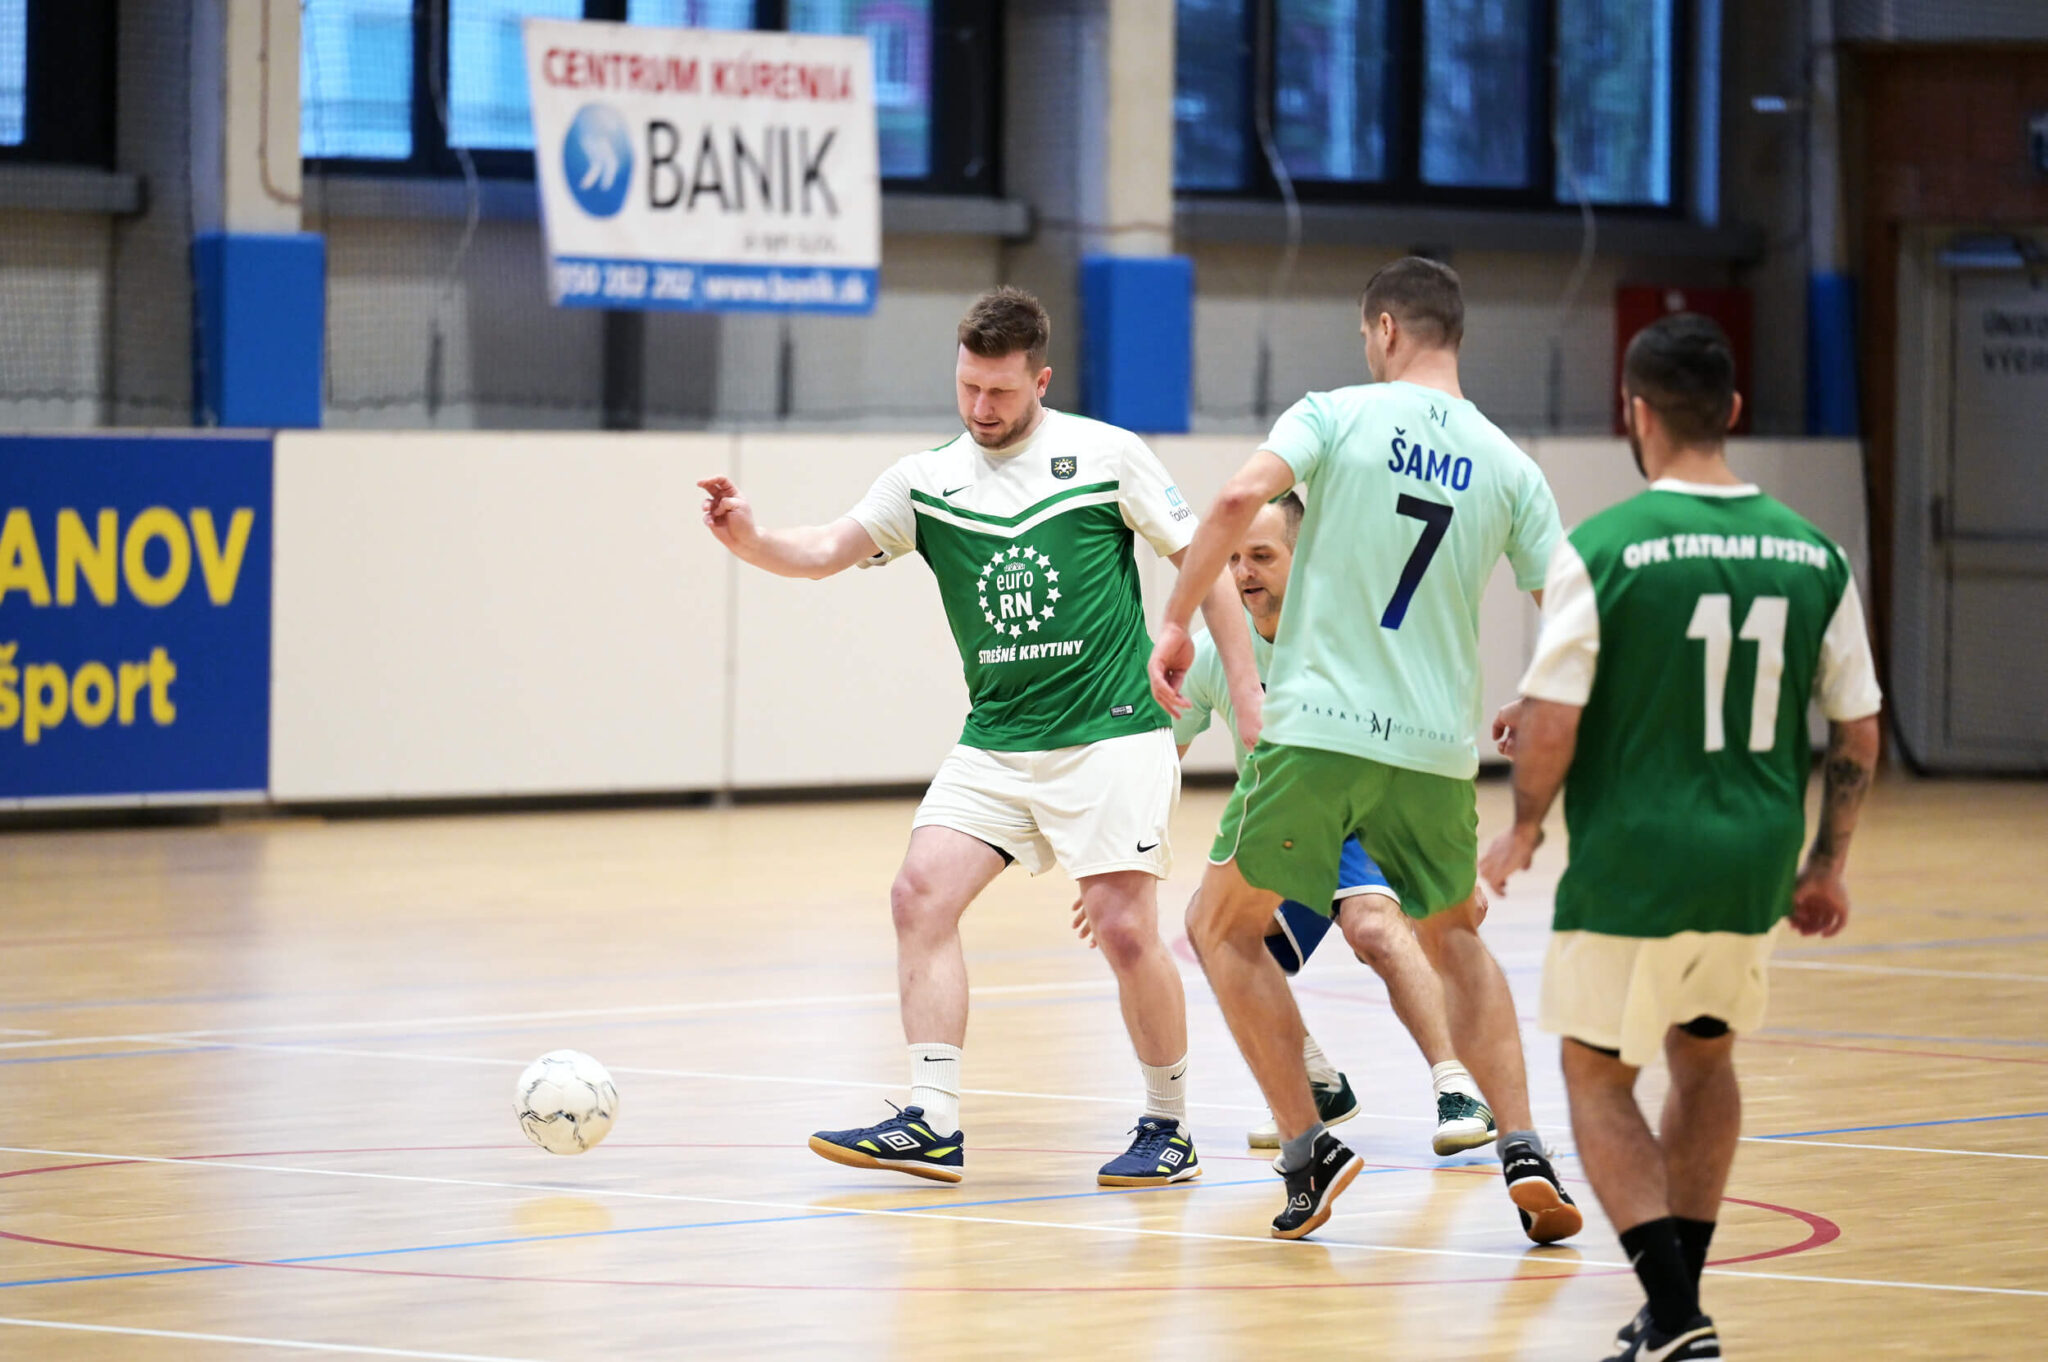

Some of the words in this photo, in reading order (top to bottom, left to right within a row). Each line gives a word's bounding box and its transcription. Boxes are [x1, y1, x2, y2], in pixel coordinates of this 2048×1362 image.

[543, 47, 700, 95] CENTRUM
[646, 119, 840, 219] BANIK
[1388, 427, 1474, 492] ŠAMO
[0, 506, 254, 607] ANOV
[996, 570, 1034, 591] euro
[1380, 492, 1454, 631] 7
[1623, 537, 1671, 569] OFK
[1673, 534, 1757, 559] TATRAN
[999, 591, 1033, 619] RN
[979, 644, 1017, 664] STREŠNÉ
[1019, 640, 1084, 661] KRYTINY
[1685, 593, 1790, 753] 11
[0, 641, 176, 745] šport
